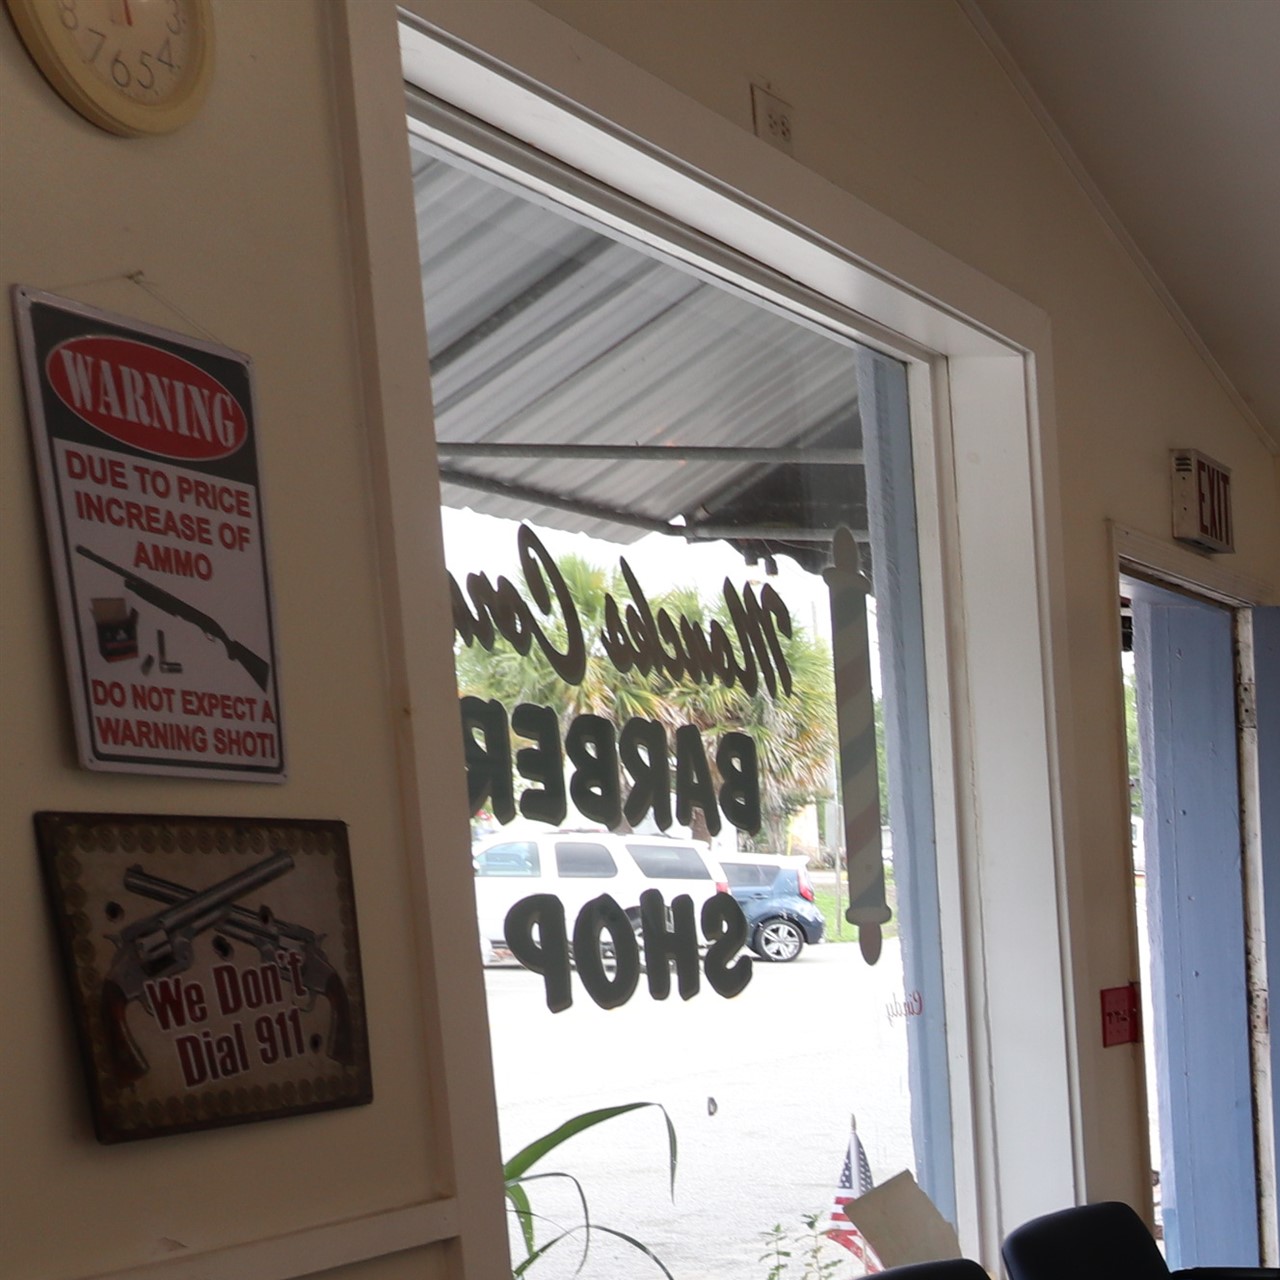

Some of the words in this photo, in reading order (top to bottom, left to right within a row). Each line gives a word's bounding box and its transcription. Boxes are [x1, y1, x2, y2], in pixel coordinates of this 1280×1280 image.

[83, 27, 106, 64] 7
[157, 37, 178, 72] 4
[111, 49, 131, 88] 6
[137, 51, 156, 90] 5
[59, 348, 236, 449] WARNING
[64, 449, 129, 491] DUE
[132, 464, 171, 499] TO
[176, 475, 253, 519] PRICE
[1197, 459, 1231, 546] EXIT
[73, 489, 214, 547] INCREASE
[217, 522, 252, 552] OF
[133, 541, 214, 582] AMMO
[91, 679, 127, 709] DO
[130, 684, 176, 714] NOT
[181, 690, 257, 721] EXPECT
[261, 700, 276, 724] A
[96, 716, 209, 754] WARNING
[213, 728, 277, 759] SHOT!
[146, 976, 208, 1031] We
[213, 951, 308, 1016] Don't
[175, 1023, 251, 1088] Dial
[256, 1008, 306, 1066] 911
